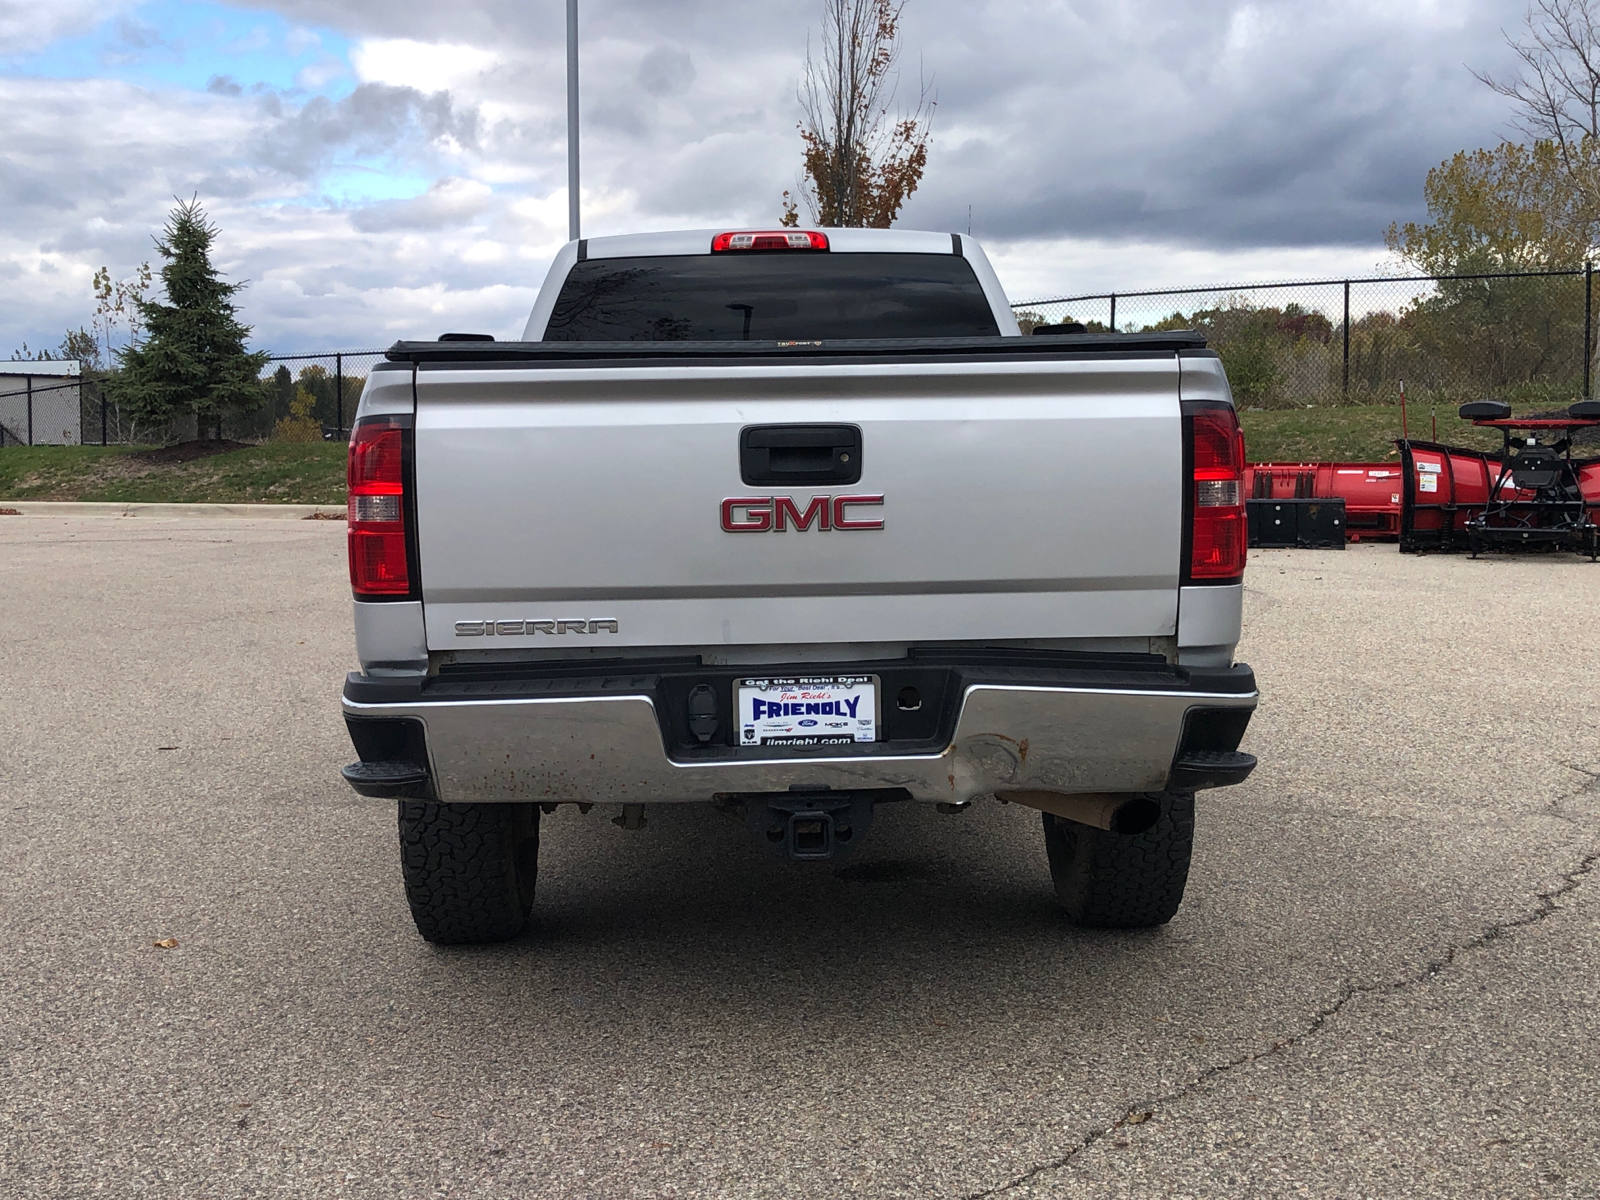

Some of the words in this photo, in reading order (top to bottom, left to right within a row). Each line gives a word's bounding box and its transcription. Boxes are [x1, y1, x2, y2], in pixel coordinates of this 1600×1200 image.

[720, 493, 885, 533] GMC
[455, 617, 619, 636] SIERRA
[837, 676, 868, 684] Deal
[779, 693, 798, 702] Jim
[800, 692, 832, 701] Riehl's
[752, 695, 861, 722] FRIENDLY
